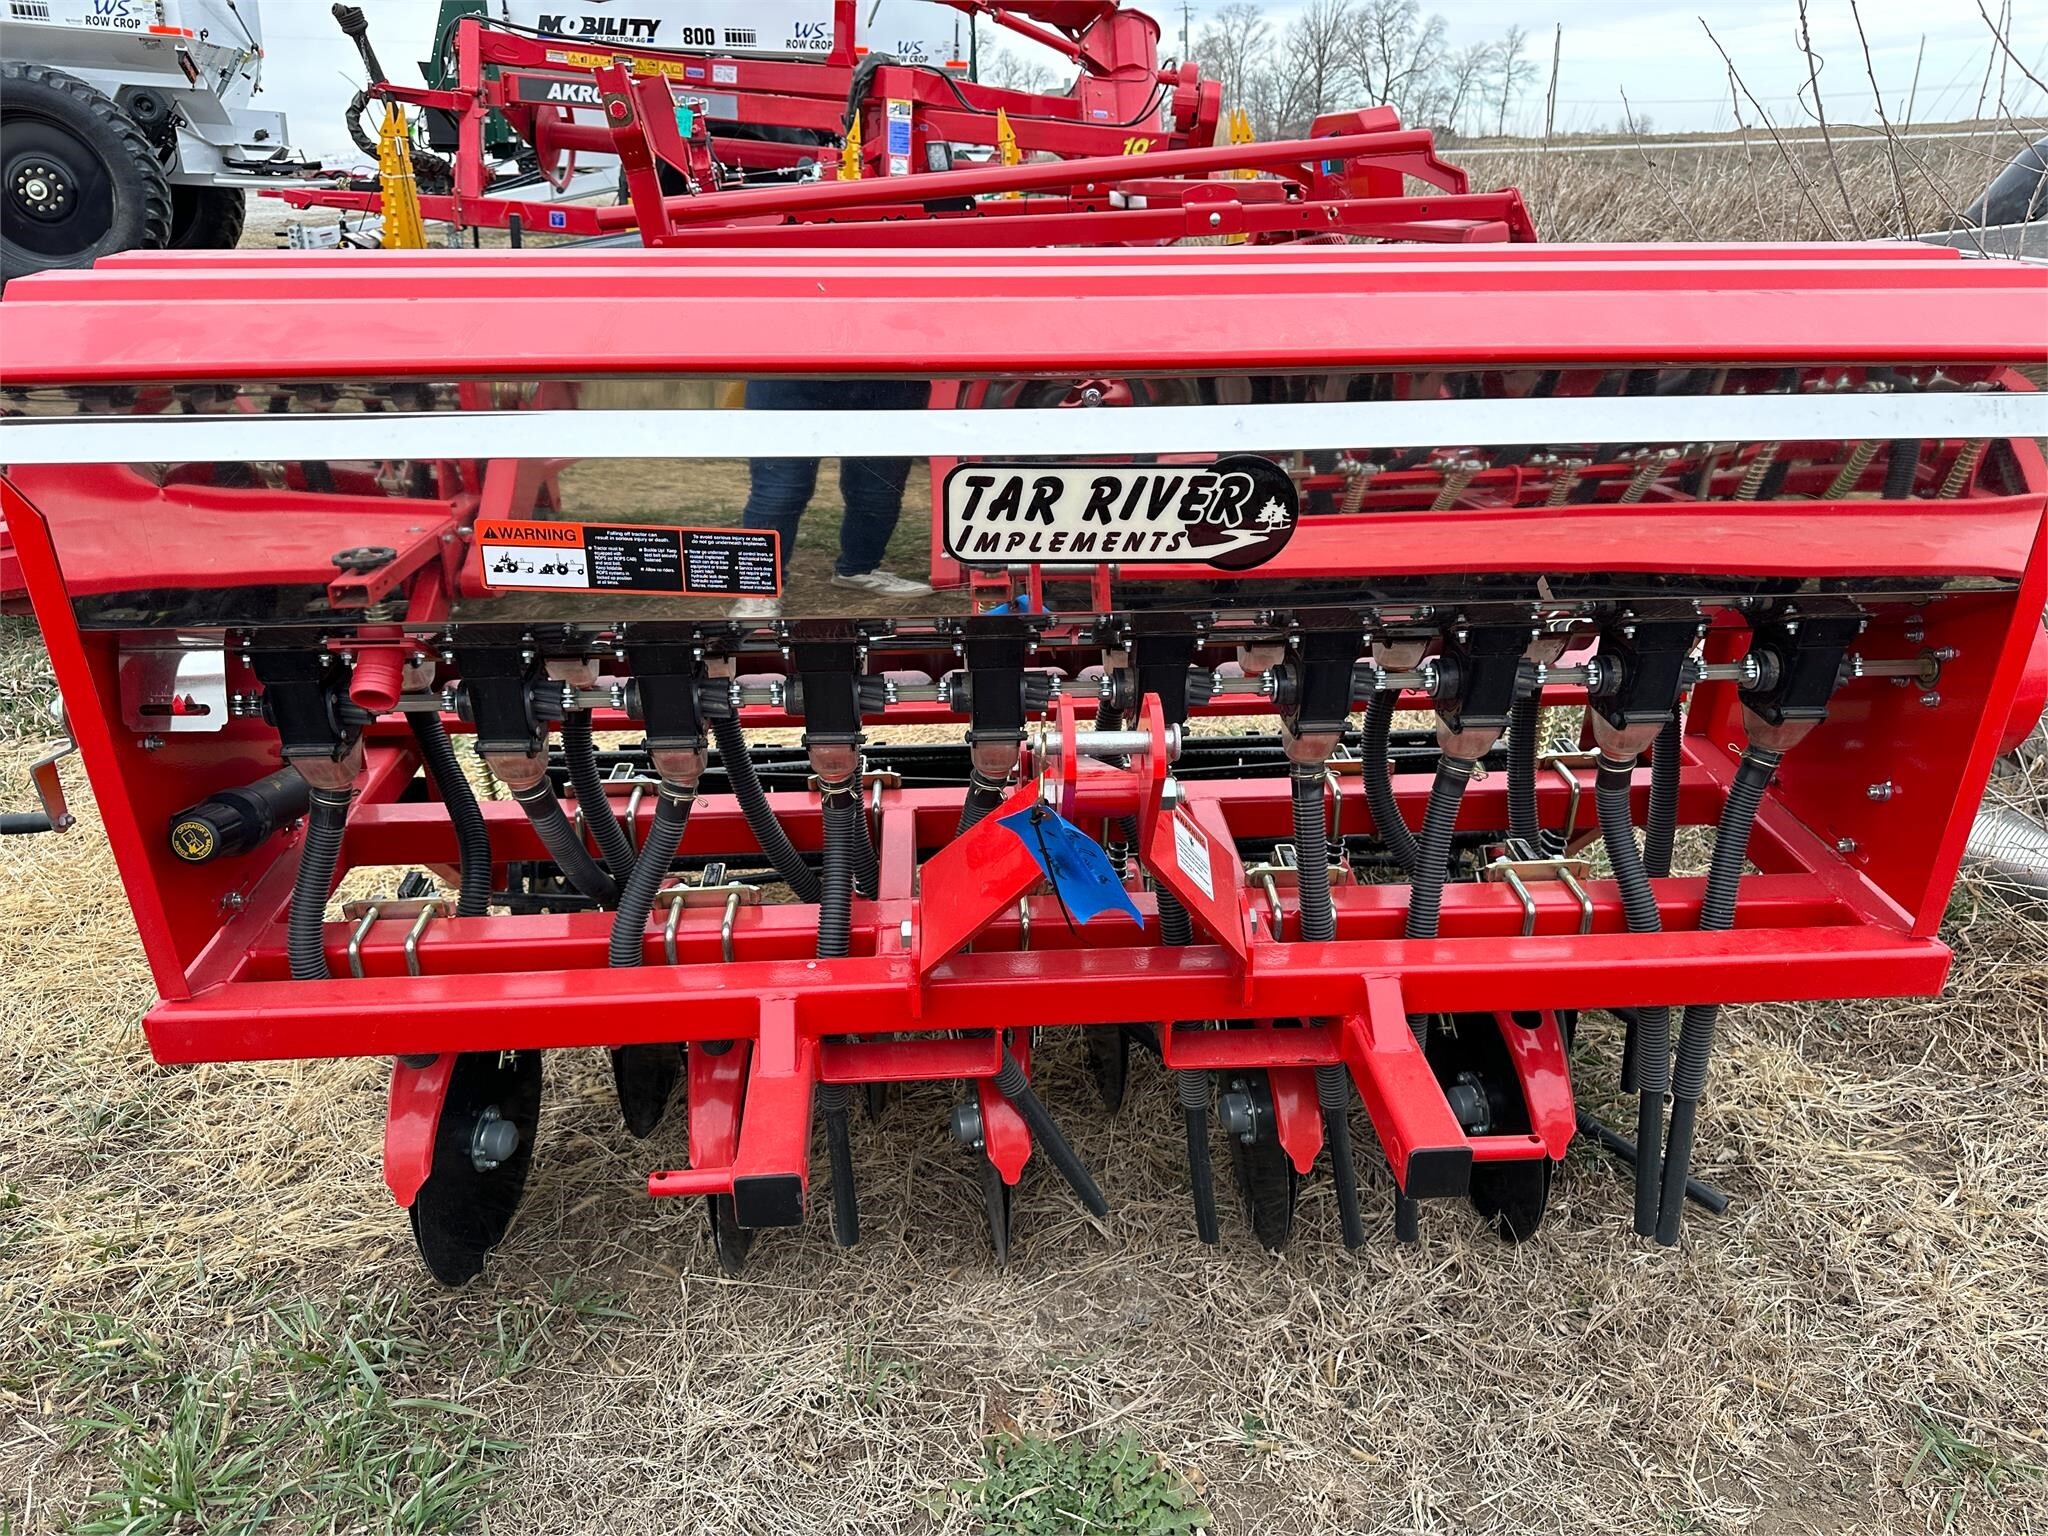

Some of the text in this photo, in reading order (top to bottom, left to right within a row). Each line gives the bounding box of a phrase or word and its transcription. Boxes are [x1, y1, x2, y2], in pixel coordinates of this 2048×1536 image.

[85, 15, 110, 27] ROW
[113, 17, 141, 29] CROP
[538, 15, 662, 37] MOBILITY
[794, 22, 827, 39] WS
[683, 27, 715, 46] 800
[785, 39, 833, 50] ROW CROP
[909, 55, 929, 63] CROP
[961, 474, 1252, 528] TAR RIVER
[498, 527, 577, 542] WARNING
[955, 524, 1189, 553] IMPLEMENTS
